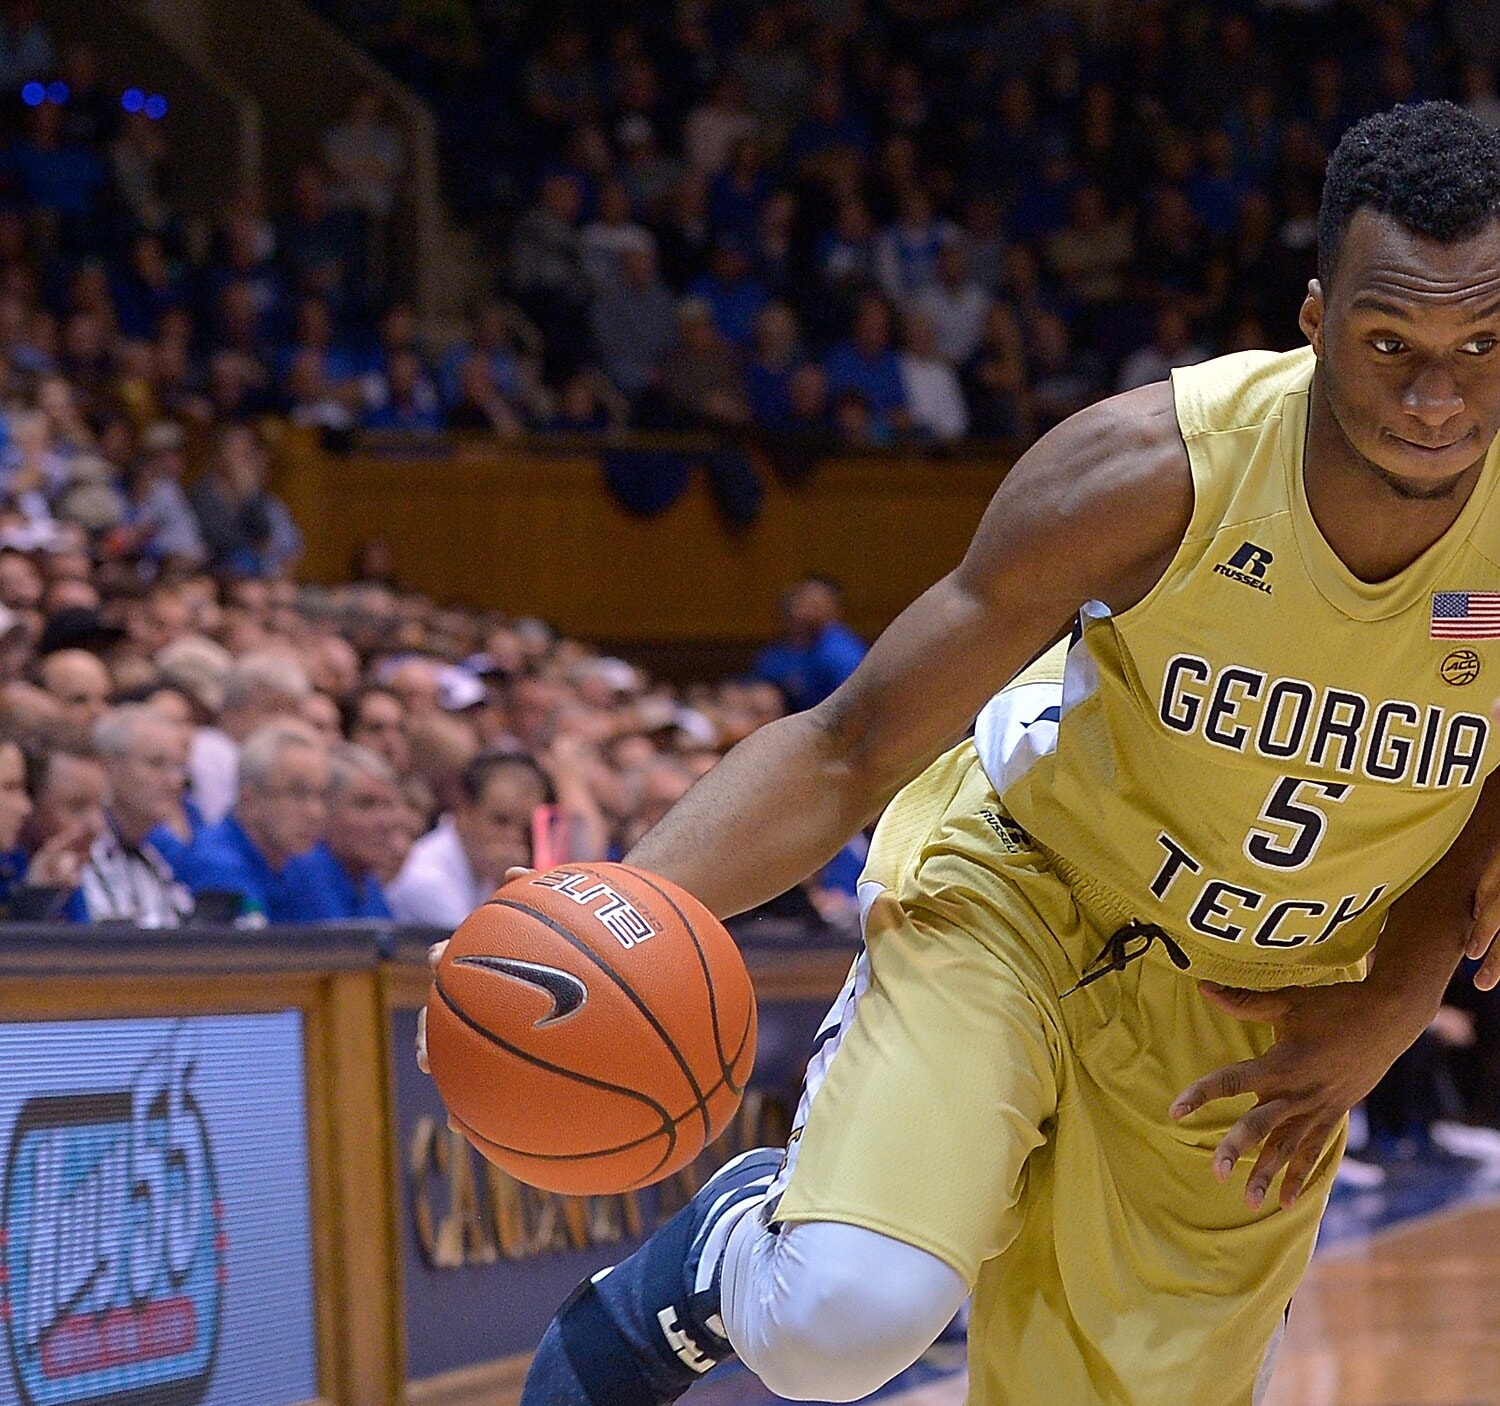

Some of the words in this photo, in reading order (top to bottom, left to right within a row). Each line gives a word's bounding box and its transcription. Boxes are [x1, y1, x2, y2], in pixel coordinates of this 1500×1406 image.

[1212, 563, 1273, 595] RUSSELL
[1445, 659, 1478, 671] ACC
[1159, 653, 1490, 789] GEORGIA
[1242, 775, 1354, 872] 5
[529, 872, 656, 950] ELITE
[1148, 829, 1389, 949] TECH
